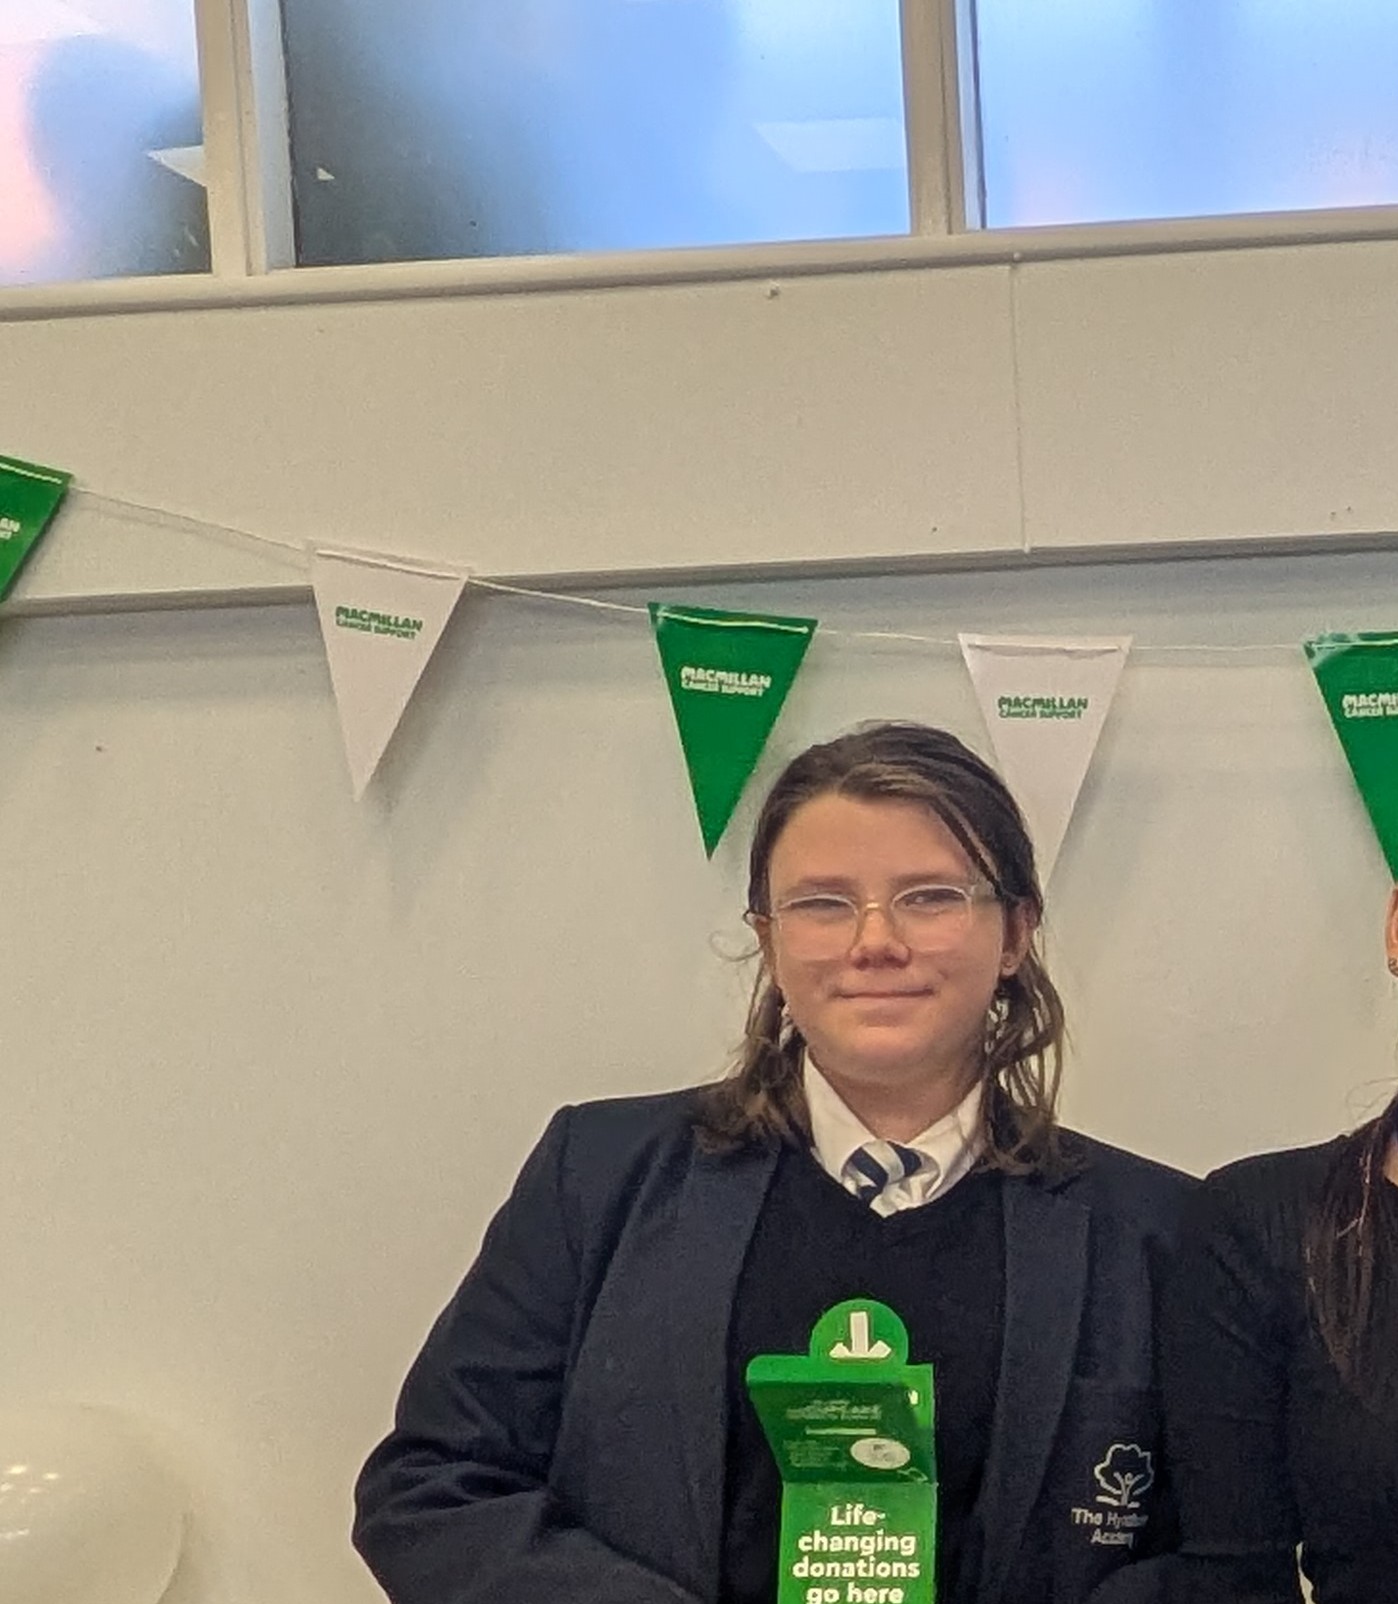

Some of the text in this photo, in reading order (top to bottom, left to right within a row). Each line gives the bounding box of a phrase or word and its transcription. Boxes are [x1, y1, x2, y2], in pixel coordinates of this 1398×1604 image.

[336, 606, 423, 631] MACMILLAN
[681, 666, 772, 689] MACMILLAN
[998, 696, 1088, 709] MACMILLAN
[830, 1504, 886, 1526] Life-
[1071, 1507, 1103, 1526] The
[798, 1529, 916, 1557] changing
[792, 1555, 920, 1578] donations
[847, 1581, 904, 1604] here
